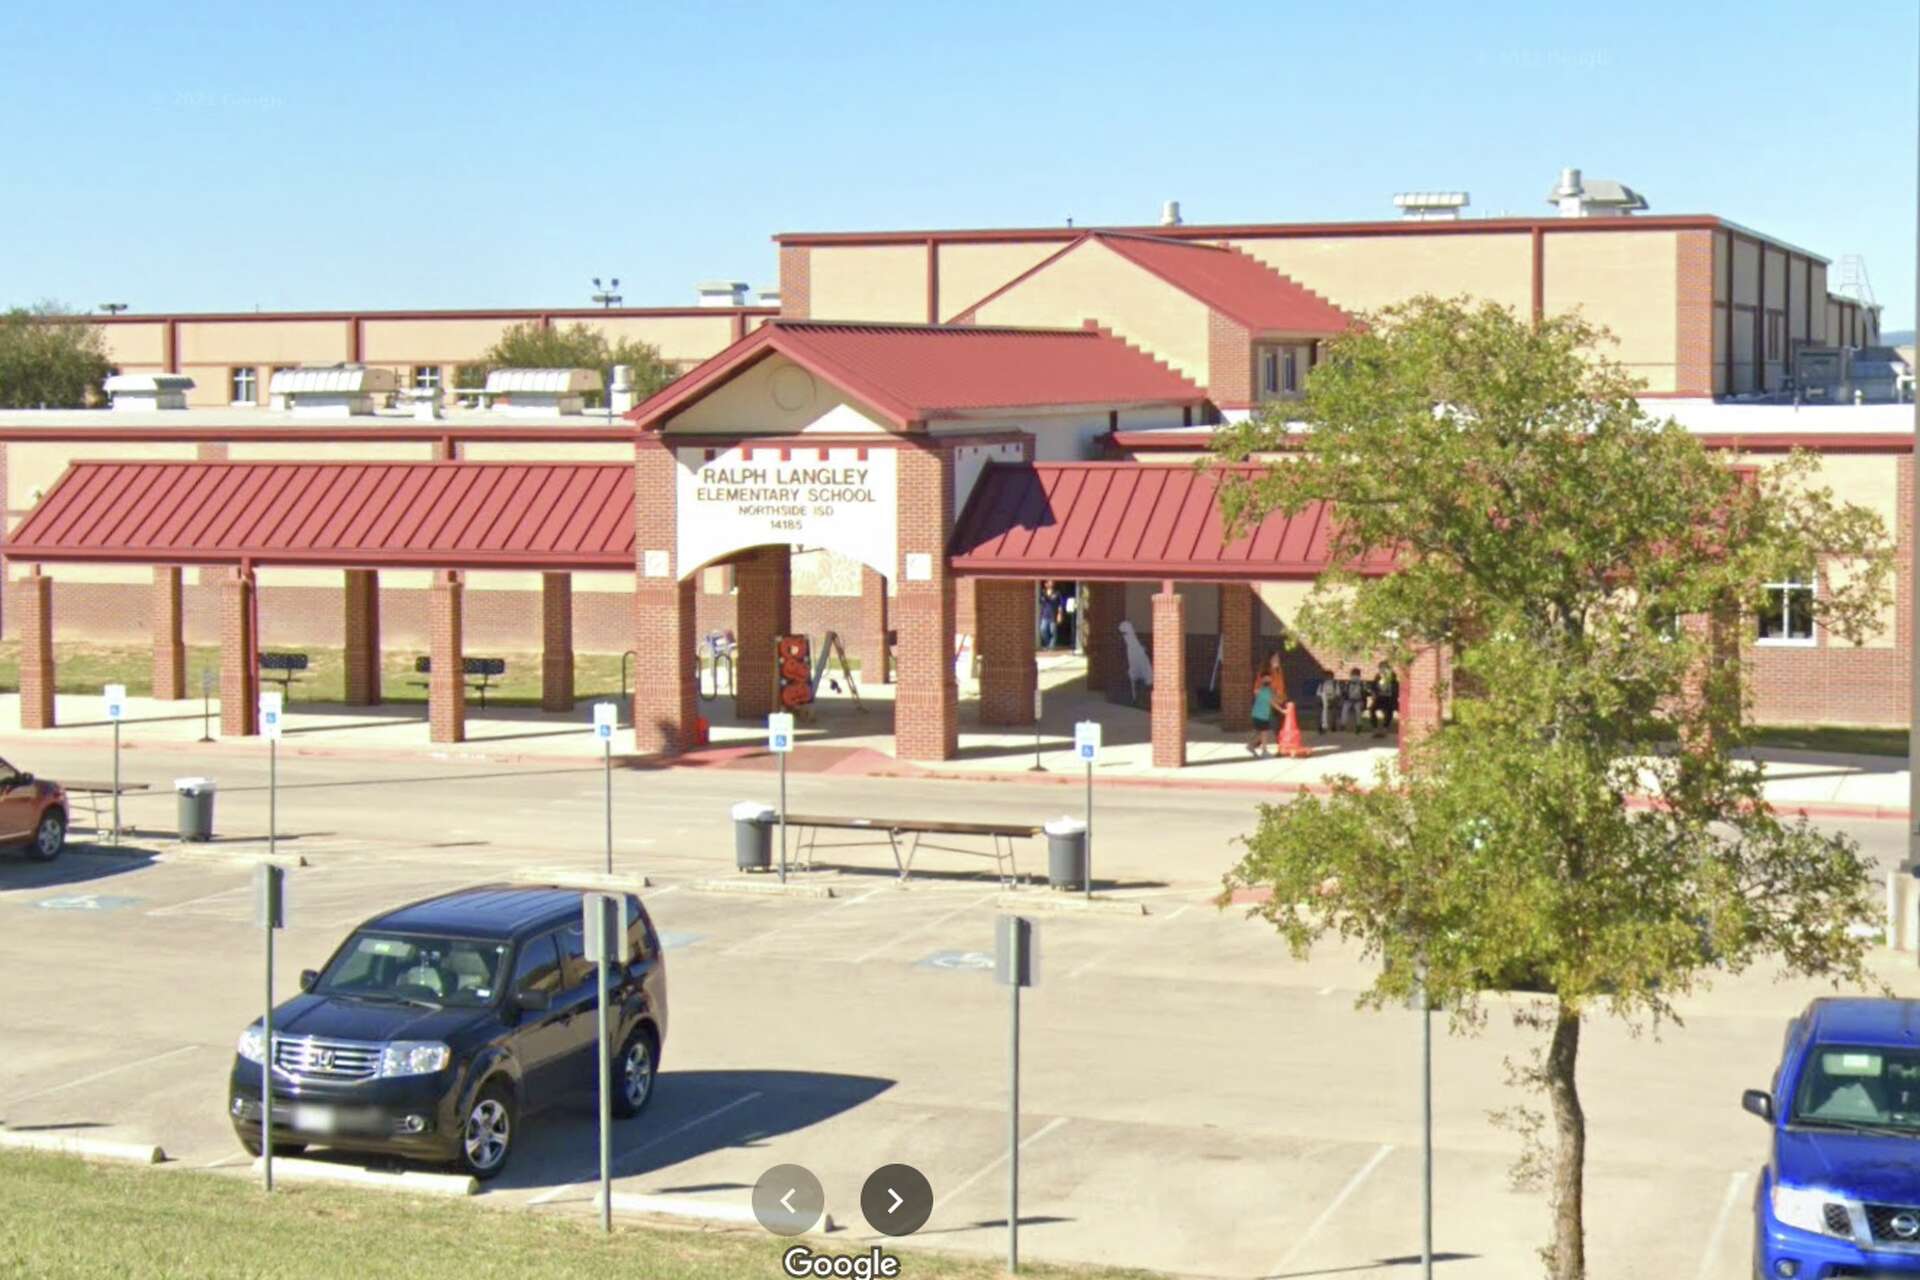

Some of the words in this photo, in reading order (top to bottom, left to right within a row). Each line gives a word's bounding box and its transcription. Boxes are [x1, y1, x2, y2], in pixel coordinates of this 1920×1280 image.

[703, 468, 766, 485] RALPH
[776, 468, 869, 485] LANGLEY
[697, 488, 800, 502] ELEMENTARY
[808, 488, 876, 502] SCHOOL
[738, 505, 807, 516] NORTHSIDE
[813, 505, 834, 516] ISD
